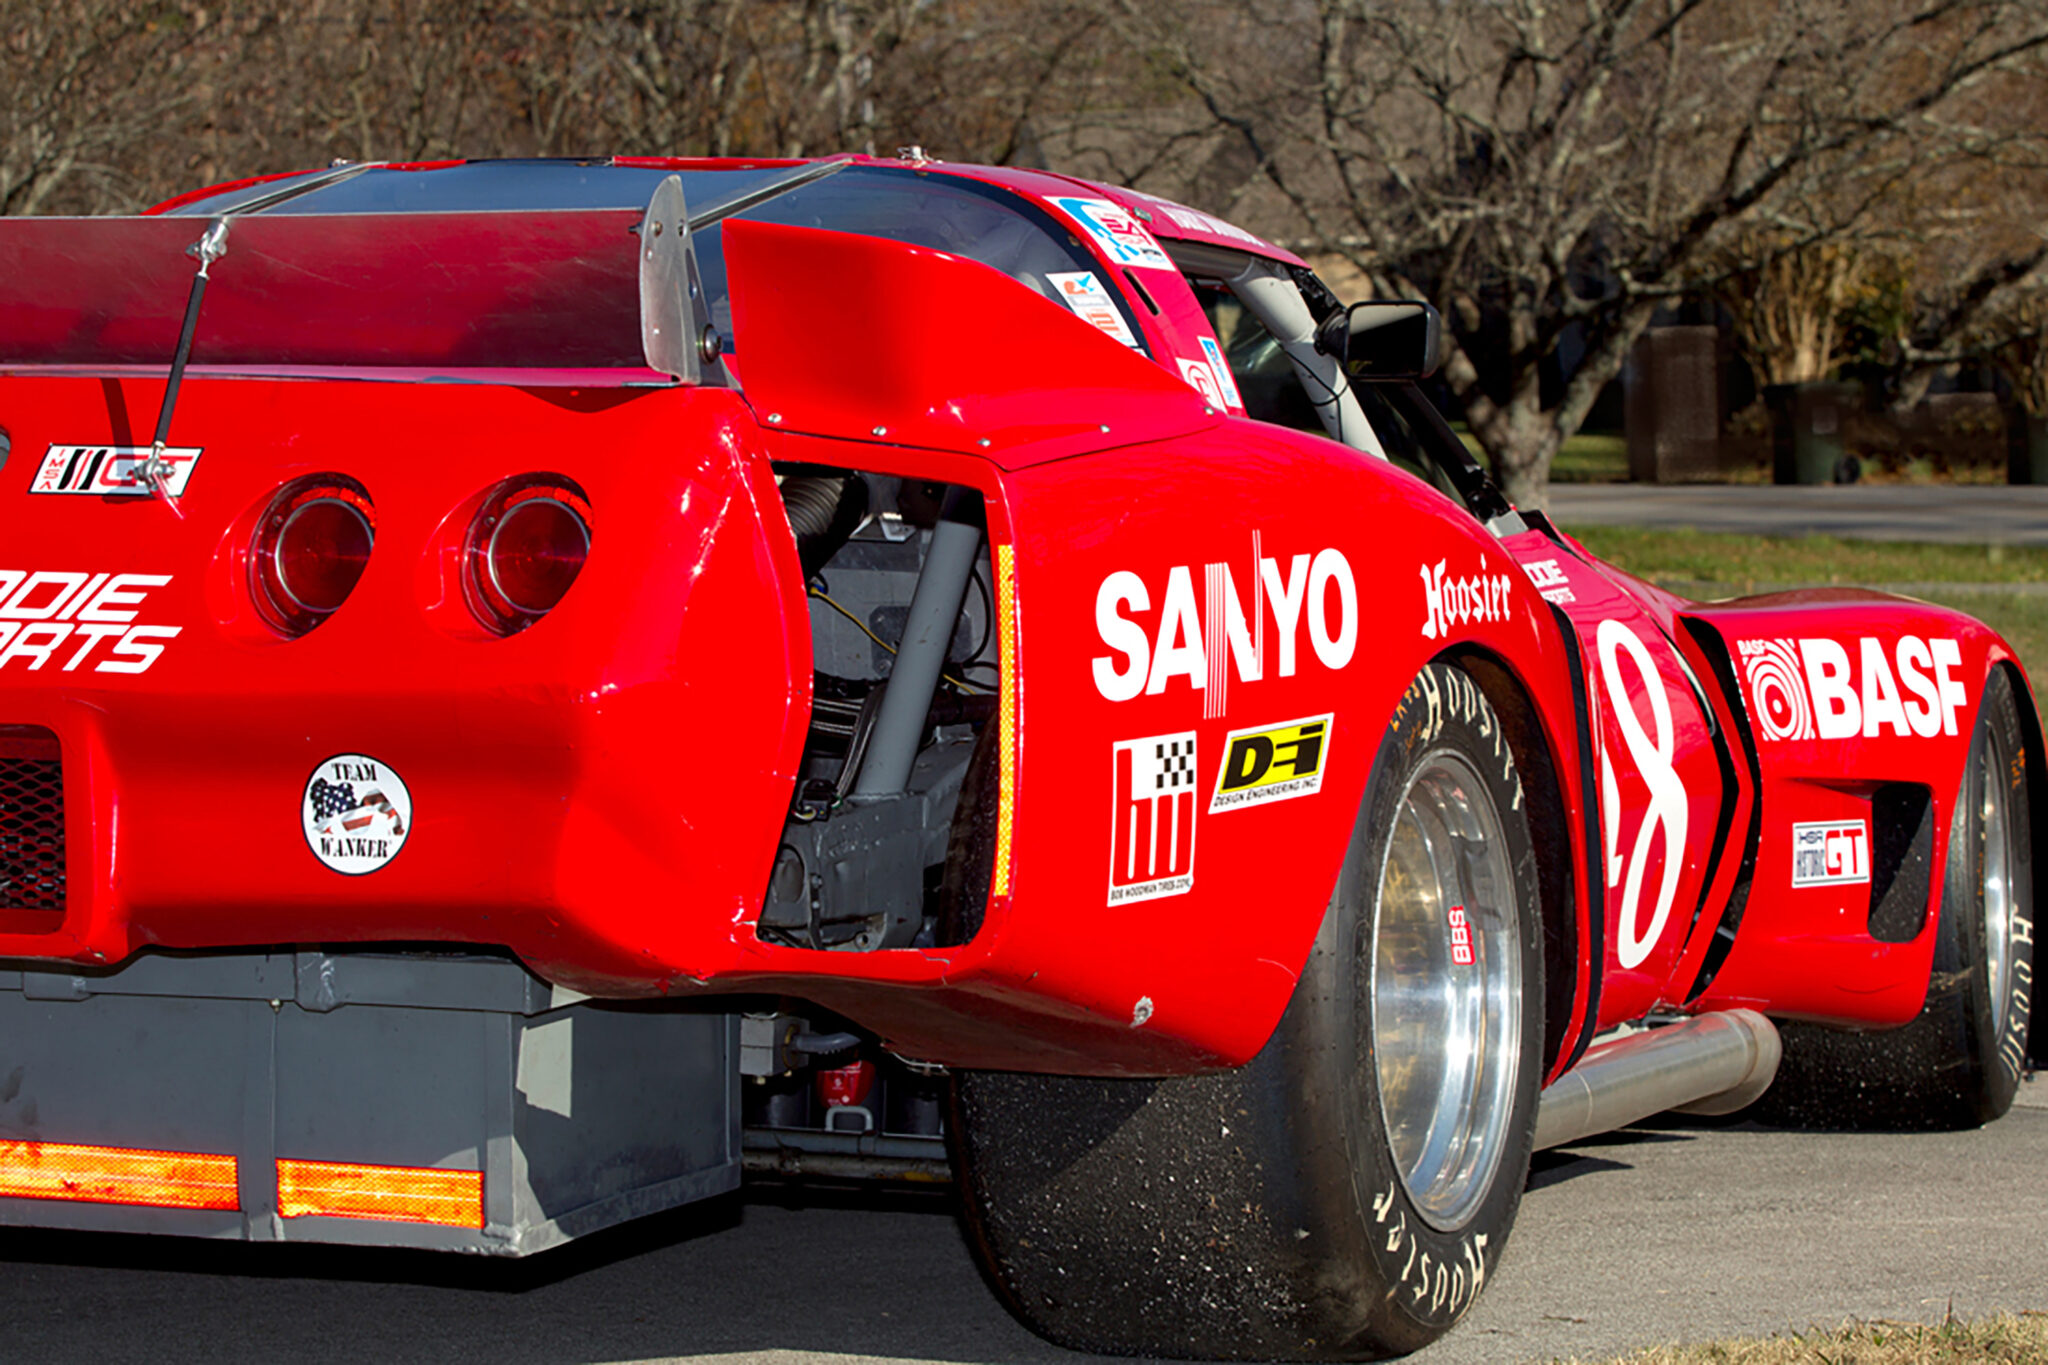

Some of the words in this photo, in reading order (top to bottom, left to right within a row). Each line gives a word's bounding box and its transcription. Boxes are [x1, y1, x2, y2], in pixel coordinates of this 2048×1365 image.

[1420, 552, 1512, 640] Hoosier
[0, 622, 183, 674] RTS
[1092, 530, 1359, 718] SANYO
[1799, 635, 1967, 739] BASF
[331, 762, 377, 781] TEAM
[1214, 793, 1244, 807] DESIGN
[1246, 781, 1300, 801] ENGINEERING
[320, 837, 388, 858] WANKER
[1825, 828, 1863, 876] GT
[1448, 905, 1476, 965] BBS
